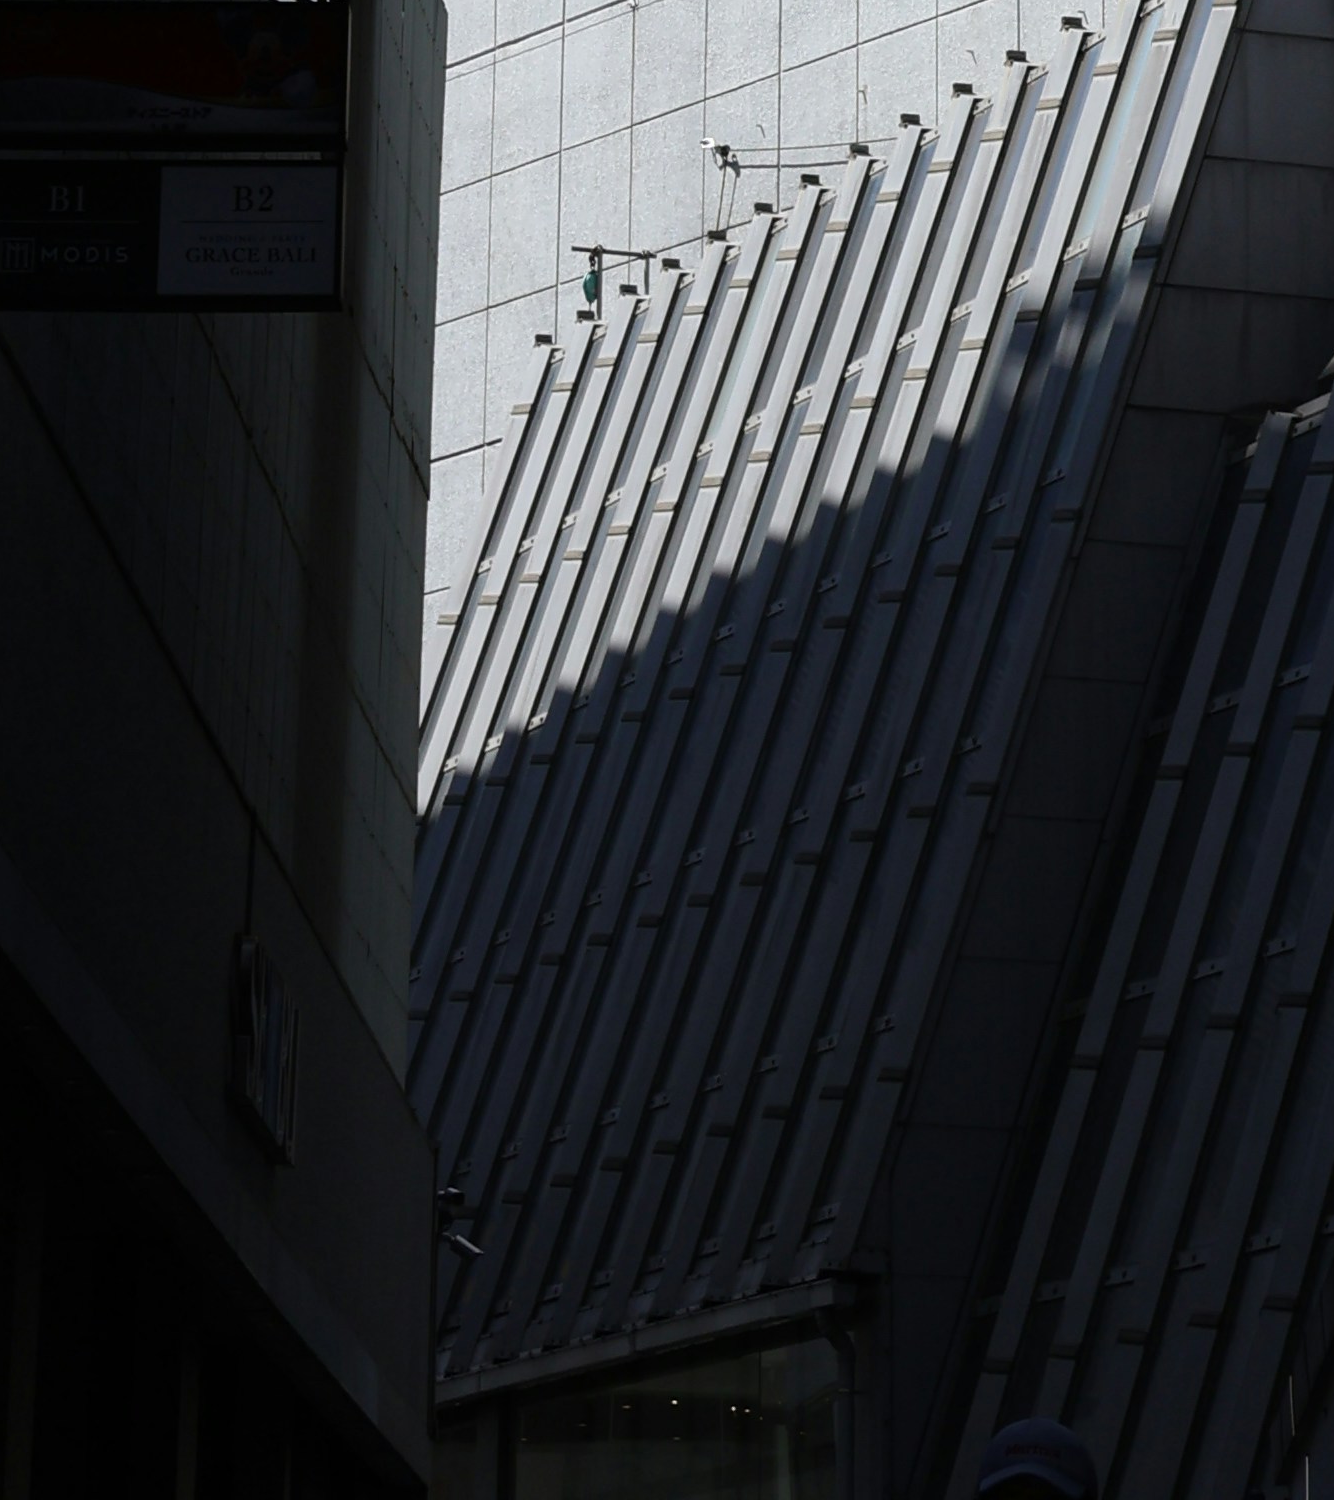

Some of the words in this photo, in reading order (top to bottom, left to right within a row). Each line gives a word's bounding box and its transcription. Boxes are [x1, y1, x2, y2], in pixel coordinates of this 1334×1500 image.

[47, 184, 85, 213] B1
[233, 185, 275, 212] B2
[40, 245, 130, 263] MODIS
[185, 247, 260, 263] GRACE
[267, 247, 316, 263] BALI
